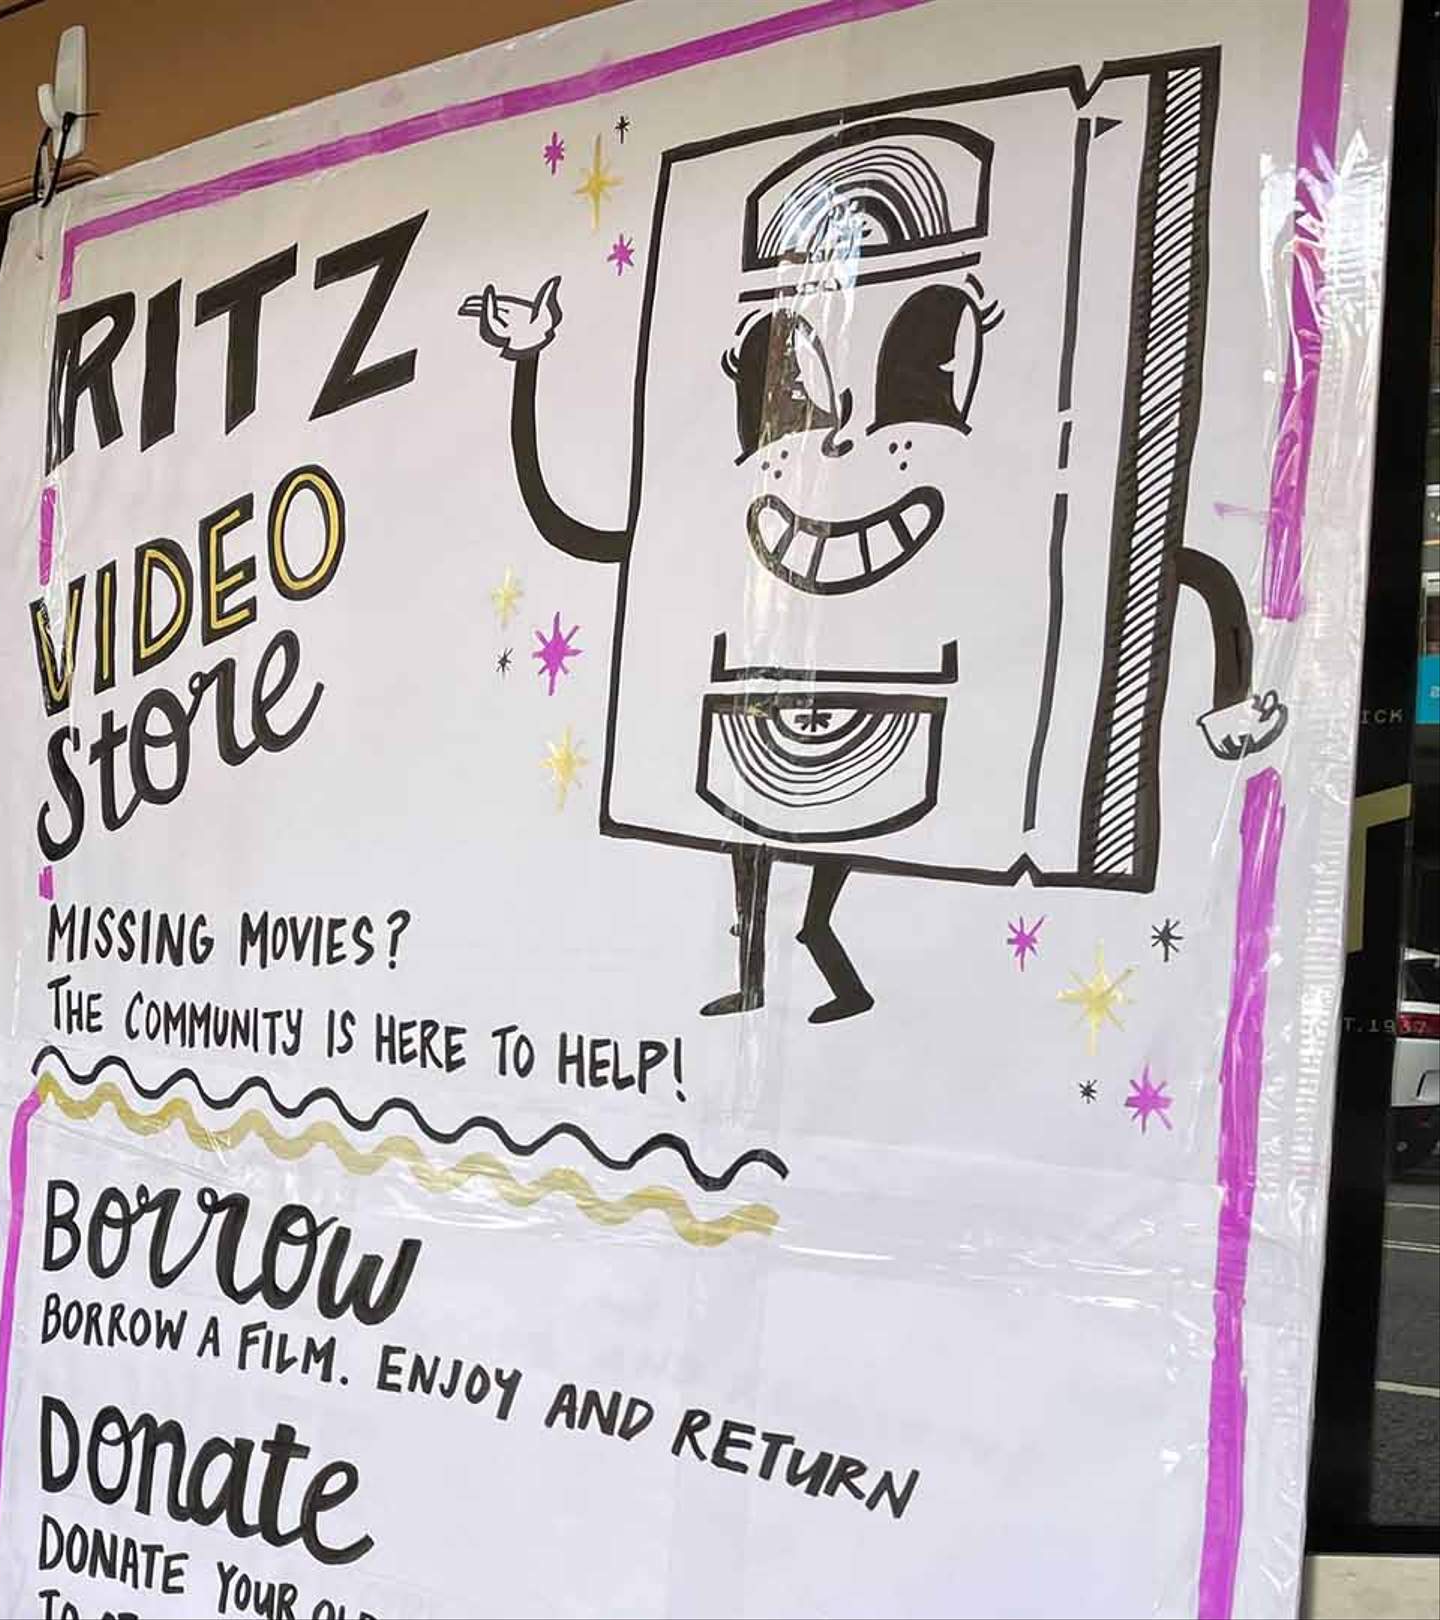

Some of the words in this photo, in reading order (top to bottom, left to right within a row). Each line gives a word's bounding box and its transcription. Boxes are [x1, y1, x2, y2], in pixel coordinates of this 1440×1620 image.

[45, 209, 429, 476] RITZ
[30, 465, 345, 717] VIDEO
[37, 630, 324, 861] Store
[48, 904, 214, 966] MISSING
[241, 910, 410, 969] MOVIES?
[48, 975, 102, 1034] THE
[126, 992, 302, 1055] COMMUNITY
[328, 1010, 355, 1057] IS
[376, 1014, 466, 1072] HERE
[492, 1026, 534, 1077] TO
[559, 1033, 685, 1102] HELP!
[43, 1180, 421, 1325] Borrow
[39, 1396, 374, 1564] Donate
[42, 1293, 187, 1350] BORROW
[197, 1317, 219, 1357] A
[239, 1322, 348, 1385] FILM.
[378, 1345, 521, 1420] ENJOY
[545, 1384, 653, 1440] AND
[672, 1410, 919, 1518] RETURN
[39, 1515, 188, 1593] DONATE
[217, 1562, 297, 1620] YOUR
